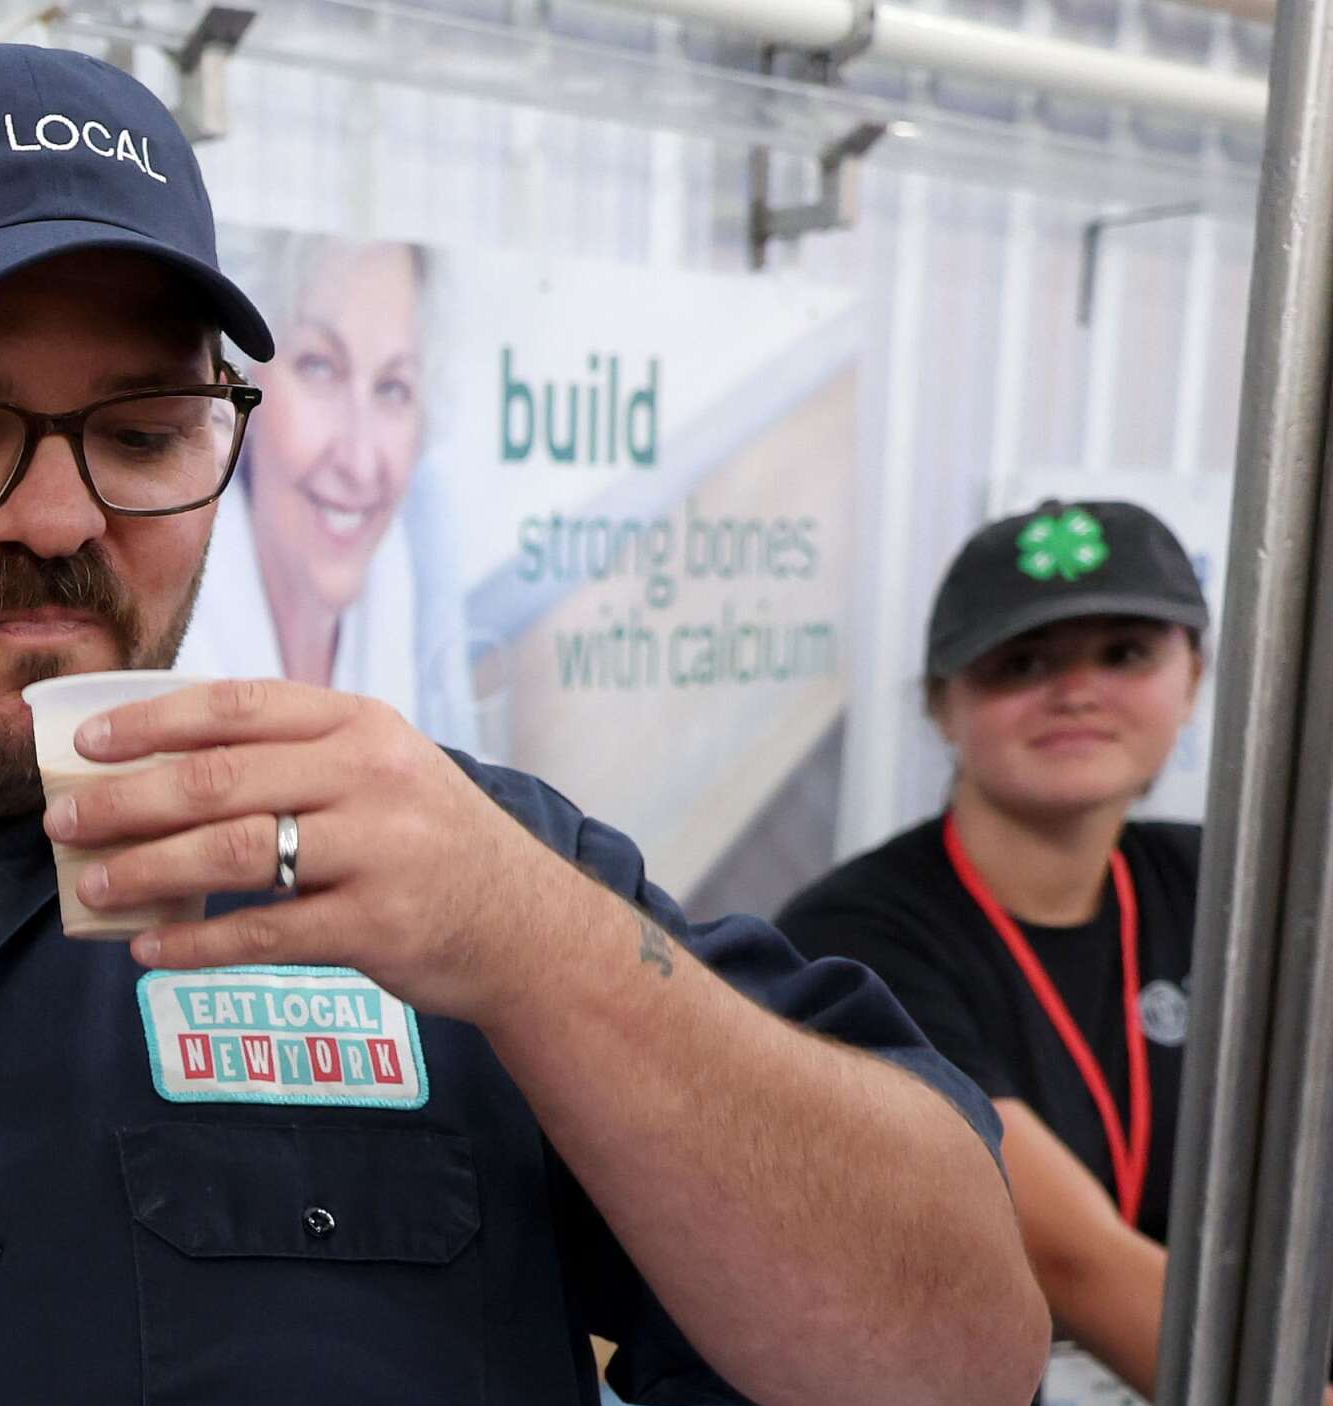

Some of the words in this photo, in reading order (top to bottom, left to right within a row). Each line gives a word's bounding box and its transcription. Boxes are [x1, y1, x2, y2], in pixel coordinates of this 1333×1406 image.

[5, 114, 167, 184] LOCAL
[501, 343, 659, 466] build
[517, 509, 676, 608] strong
[685, 500, 819, 580] bones
[556, 602, 662, 691] with
[670, 600, 834, 685] calcium
[189, 993, 256, 1025] EAT
[265, 993, 379, 1029] LOCAL
[187, 1038, 271, 1079] NEW
[284, 1039, 398, 1080] YORK
